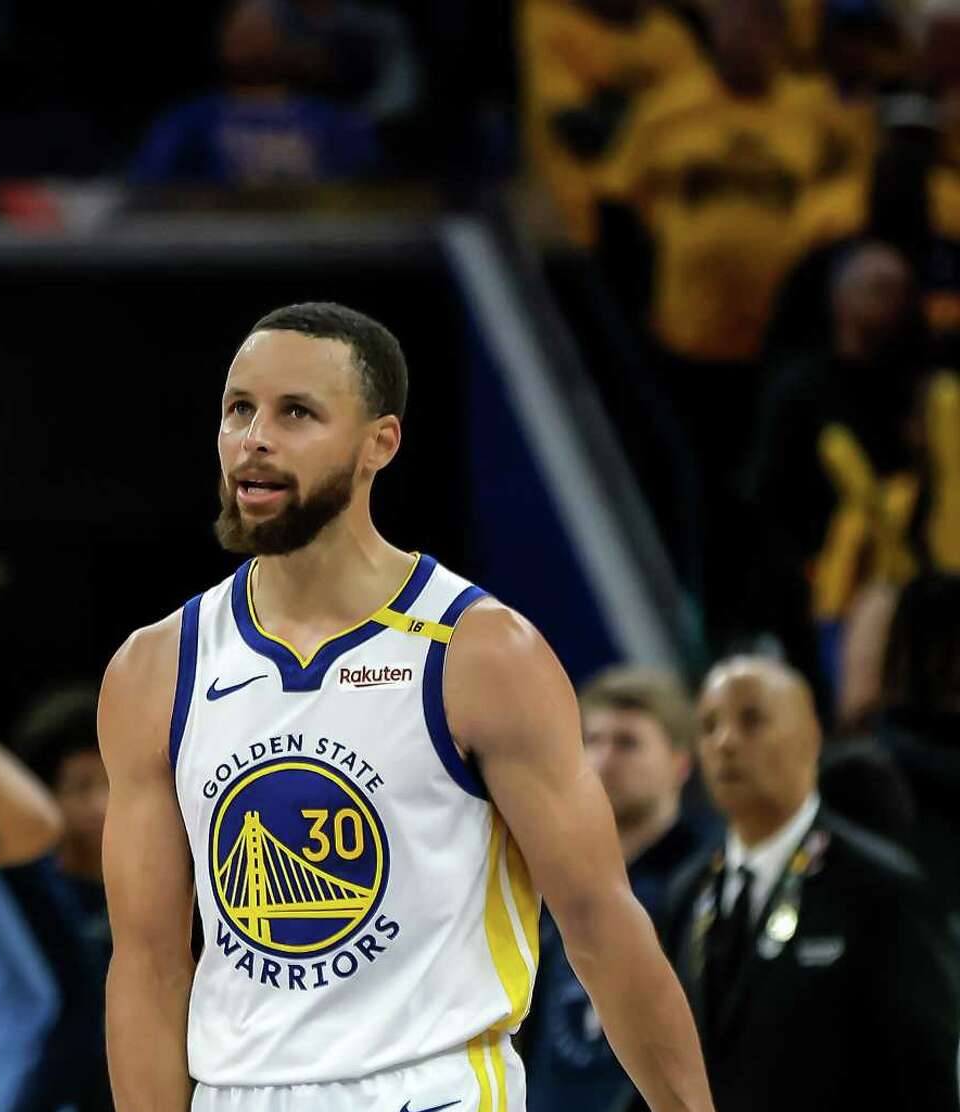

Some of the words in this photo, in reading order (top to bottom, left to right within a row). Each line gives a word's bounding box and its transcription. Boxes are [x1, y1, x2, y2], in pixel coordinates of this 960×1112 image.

[340, 667, 412, 684] Rakuten
[202, 733, 304, 799] GOLDEN
[316, 738, 385, 795] STATE
[301, 809, 364, 862] 30
[214, 913, 400, 991] WARRIORS
